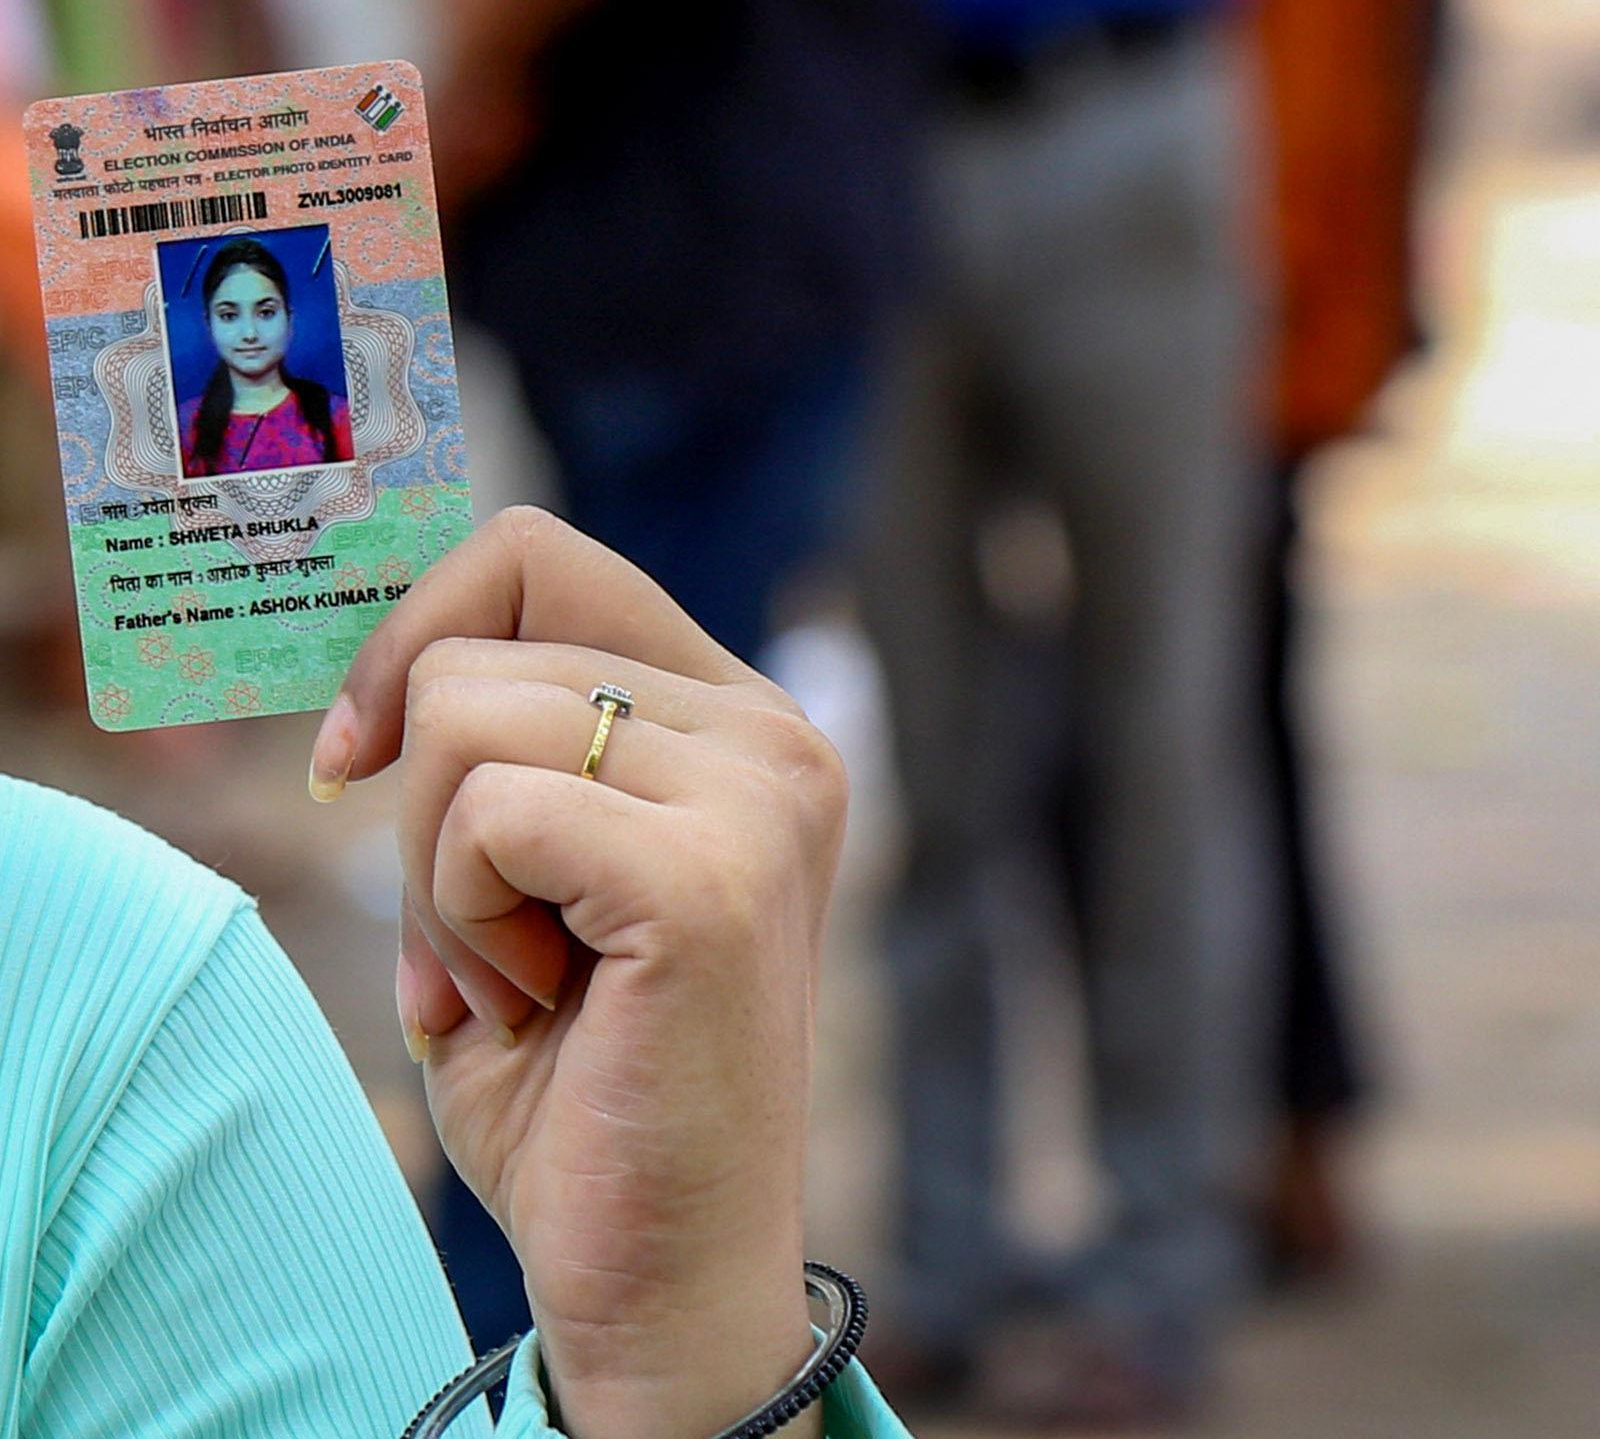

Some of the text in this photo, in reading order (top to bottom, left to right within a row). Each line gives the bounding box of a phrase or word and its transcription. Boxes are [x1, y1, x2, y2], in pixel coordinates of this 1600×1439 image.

[144, 106, 309, 141] भारत निर्वाचन आयोग
[104, 134, 356, 172] ELECTION COMMISSION OF INDIA
[214, 167, 270, 183] ELECTOR
[273, 162, 315, 175] PHOTO
[318, 156, 371, 171] IDENTITY
[378, 151, 413, 164] CARD
[298, 183, 402, 208] ZWL3009081
[106, 536, 154, 552] Name
[170, 524, 242, 545] SHWETA
[247, 516, 319, 538] SHUKLA
[144, 573, 164, 589] का
[254, 560, 293, 583] कुमार
[115, 610, 182, 631] Father's
[187, 605, 234, 623] Name
[250, 594, 310, 615] ASHOK
[315, 587, 380, 608] KUMAR
